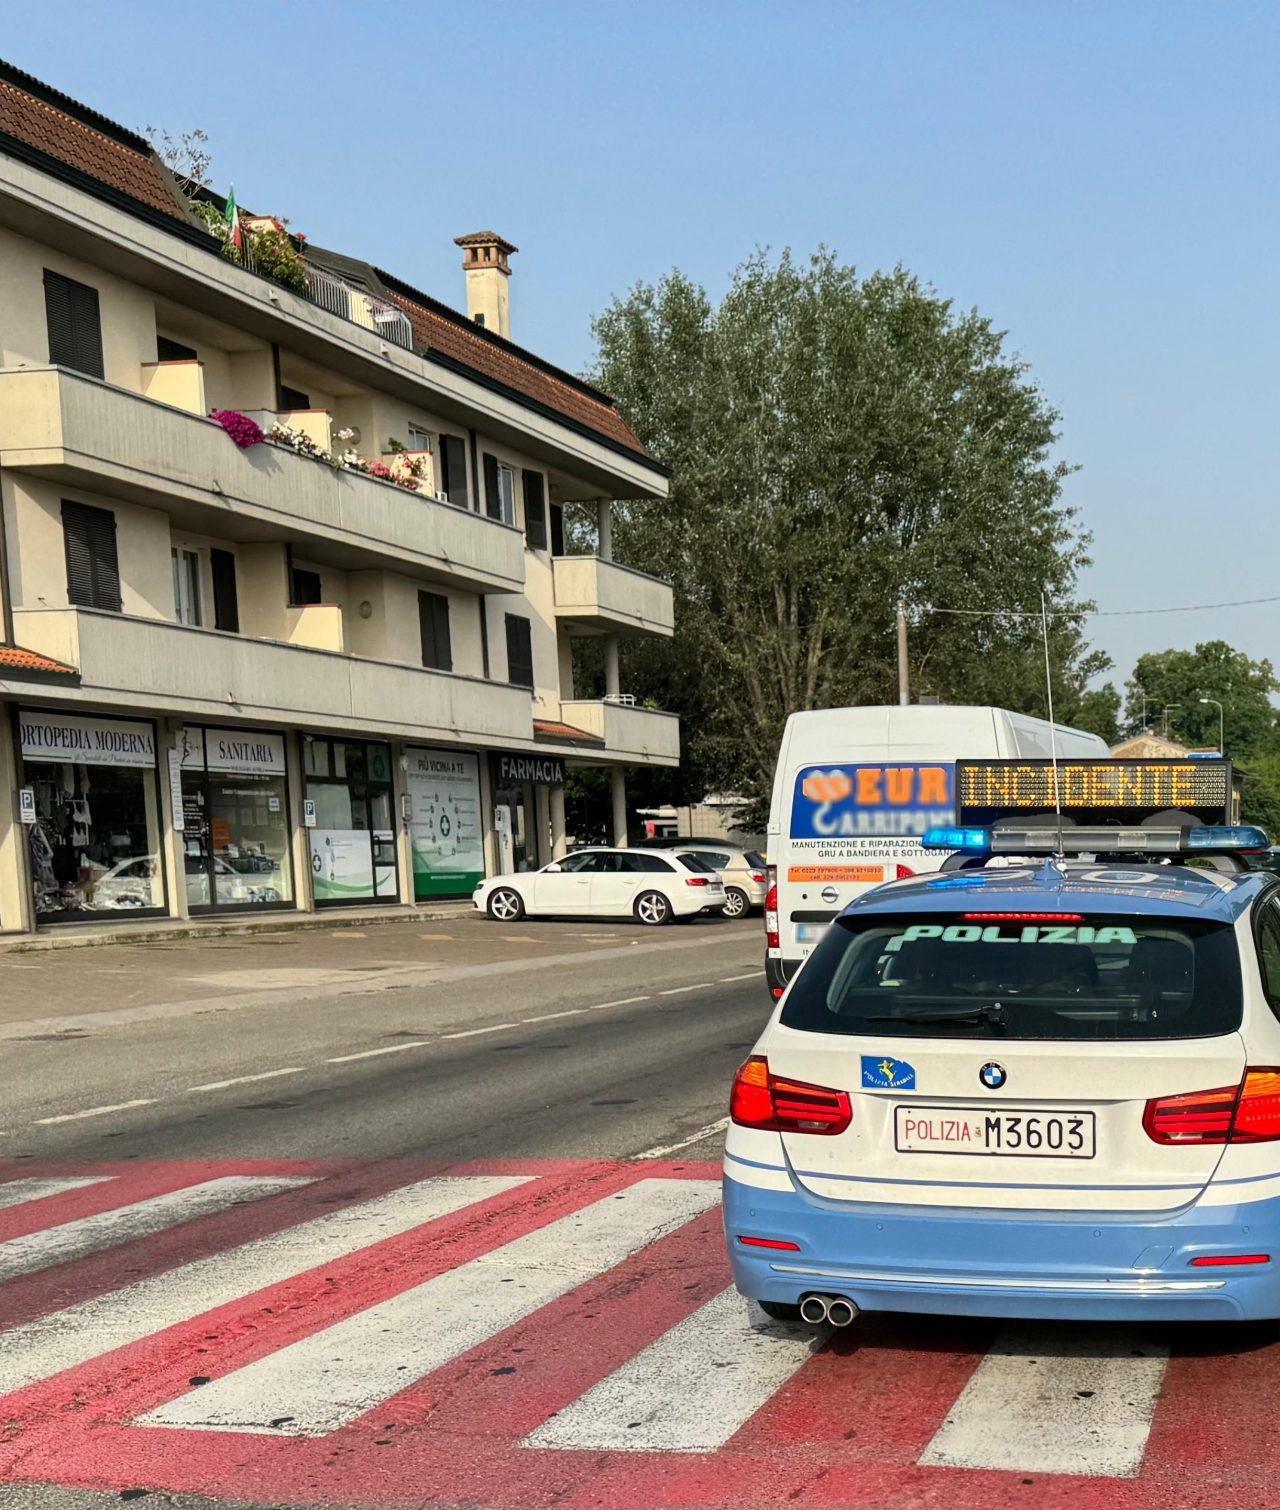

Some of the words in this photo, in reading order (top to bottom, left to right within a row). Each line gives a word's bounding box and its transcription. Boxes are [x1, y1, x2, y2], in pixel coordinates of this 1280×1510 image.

[20, 724, 92, 750] ORTOPEDIA
[95, 730, 154, 754] MODERNA
[219, 741, 274, 763] SANITARIA
[457, 763, 464, 774] TE
[501, 757, 564, 783] FARMACIA
[964, 766, 1197, 807] INCIDENTE
[24, 793, 31, 808] P
[791, 841, 858, 849] MANUTENZIONE
[904, 925, 1137, 944] POLIZIA
[905, 1120, 971, 1142] POLIZIA
[985, 1117, 1083, 1149] M3603
